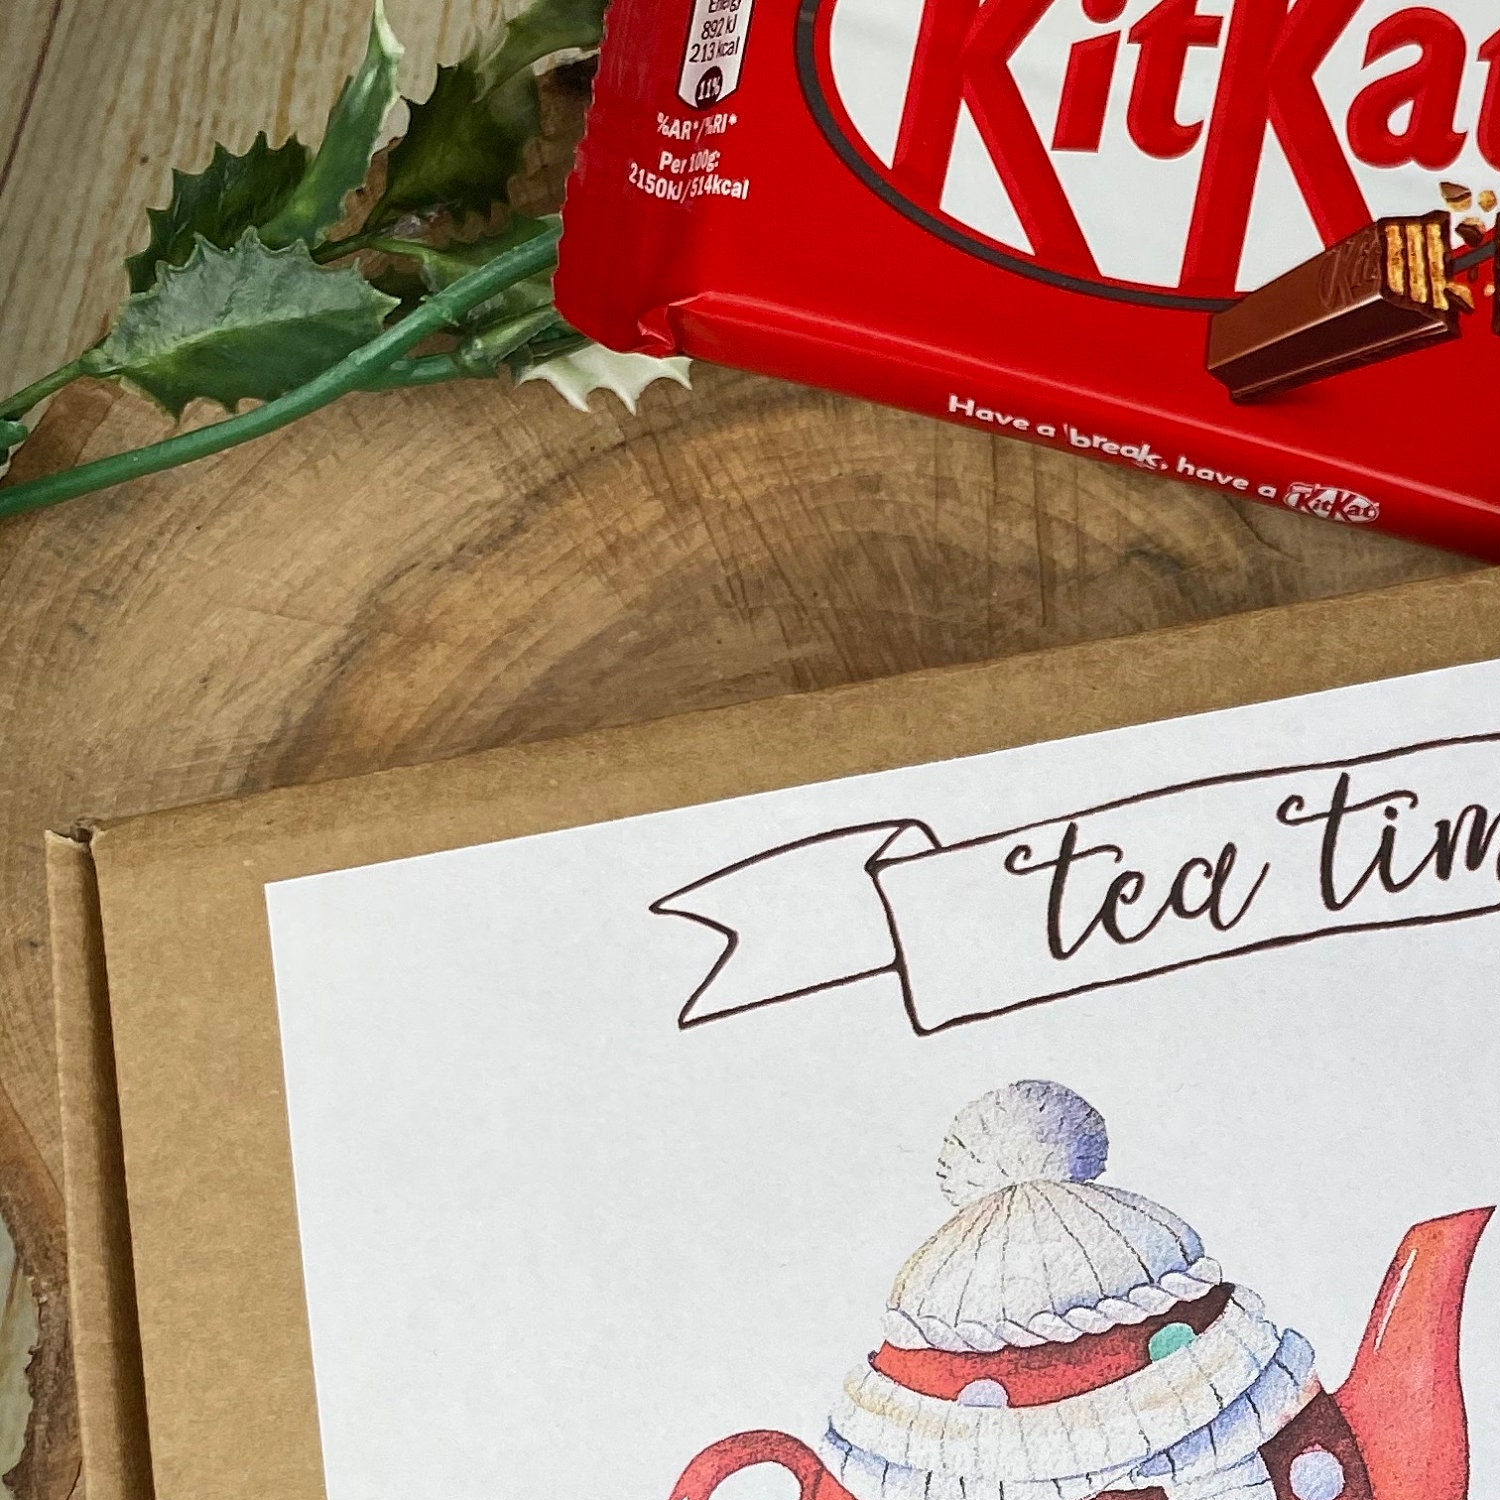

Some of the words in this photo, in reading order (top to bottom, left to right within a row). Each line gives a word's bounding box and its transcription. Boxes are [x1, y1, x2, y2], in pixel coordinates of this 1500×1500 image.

[701, 19, 725, 40] 892
[689, 43, 714, 63] 213
[715, 37, 740, 60] kcal
[698, 77, 721, 100] 11%
[659, 150, 686, 174] Per
[947, 394, 1030, 432] Have
[1036, 422, 1056, 439] a
[1177, 456, 1249, 491] have
[1257, 484, 1277, 499] a
[1286, 482, 1380, 524] KitKat
[1004, 822, 1269, 960] tea
